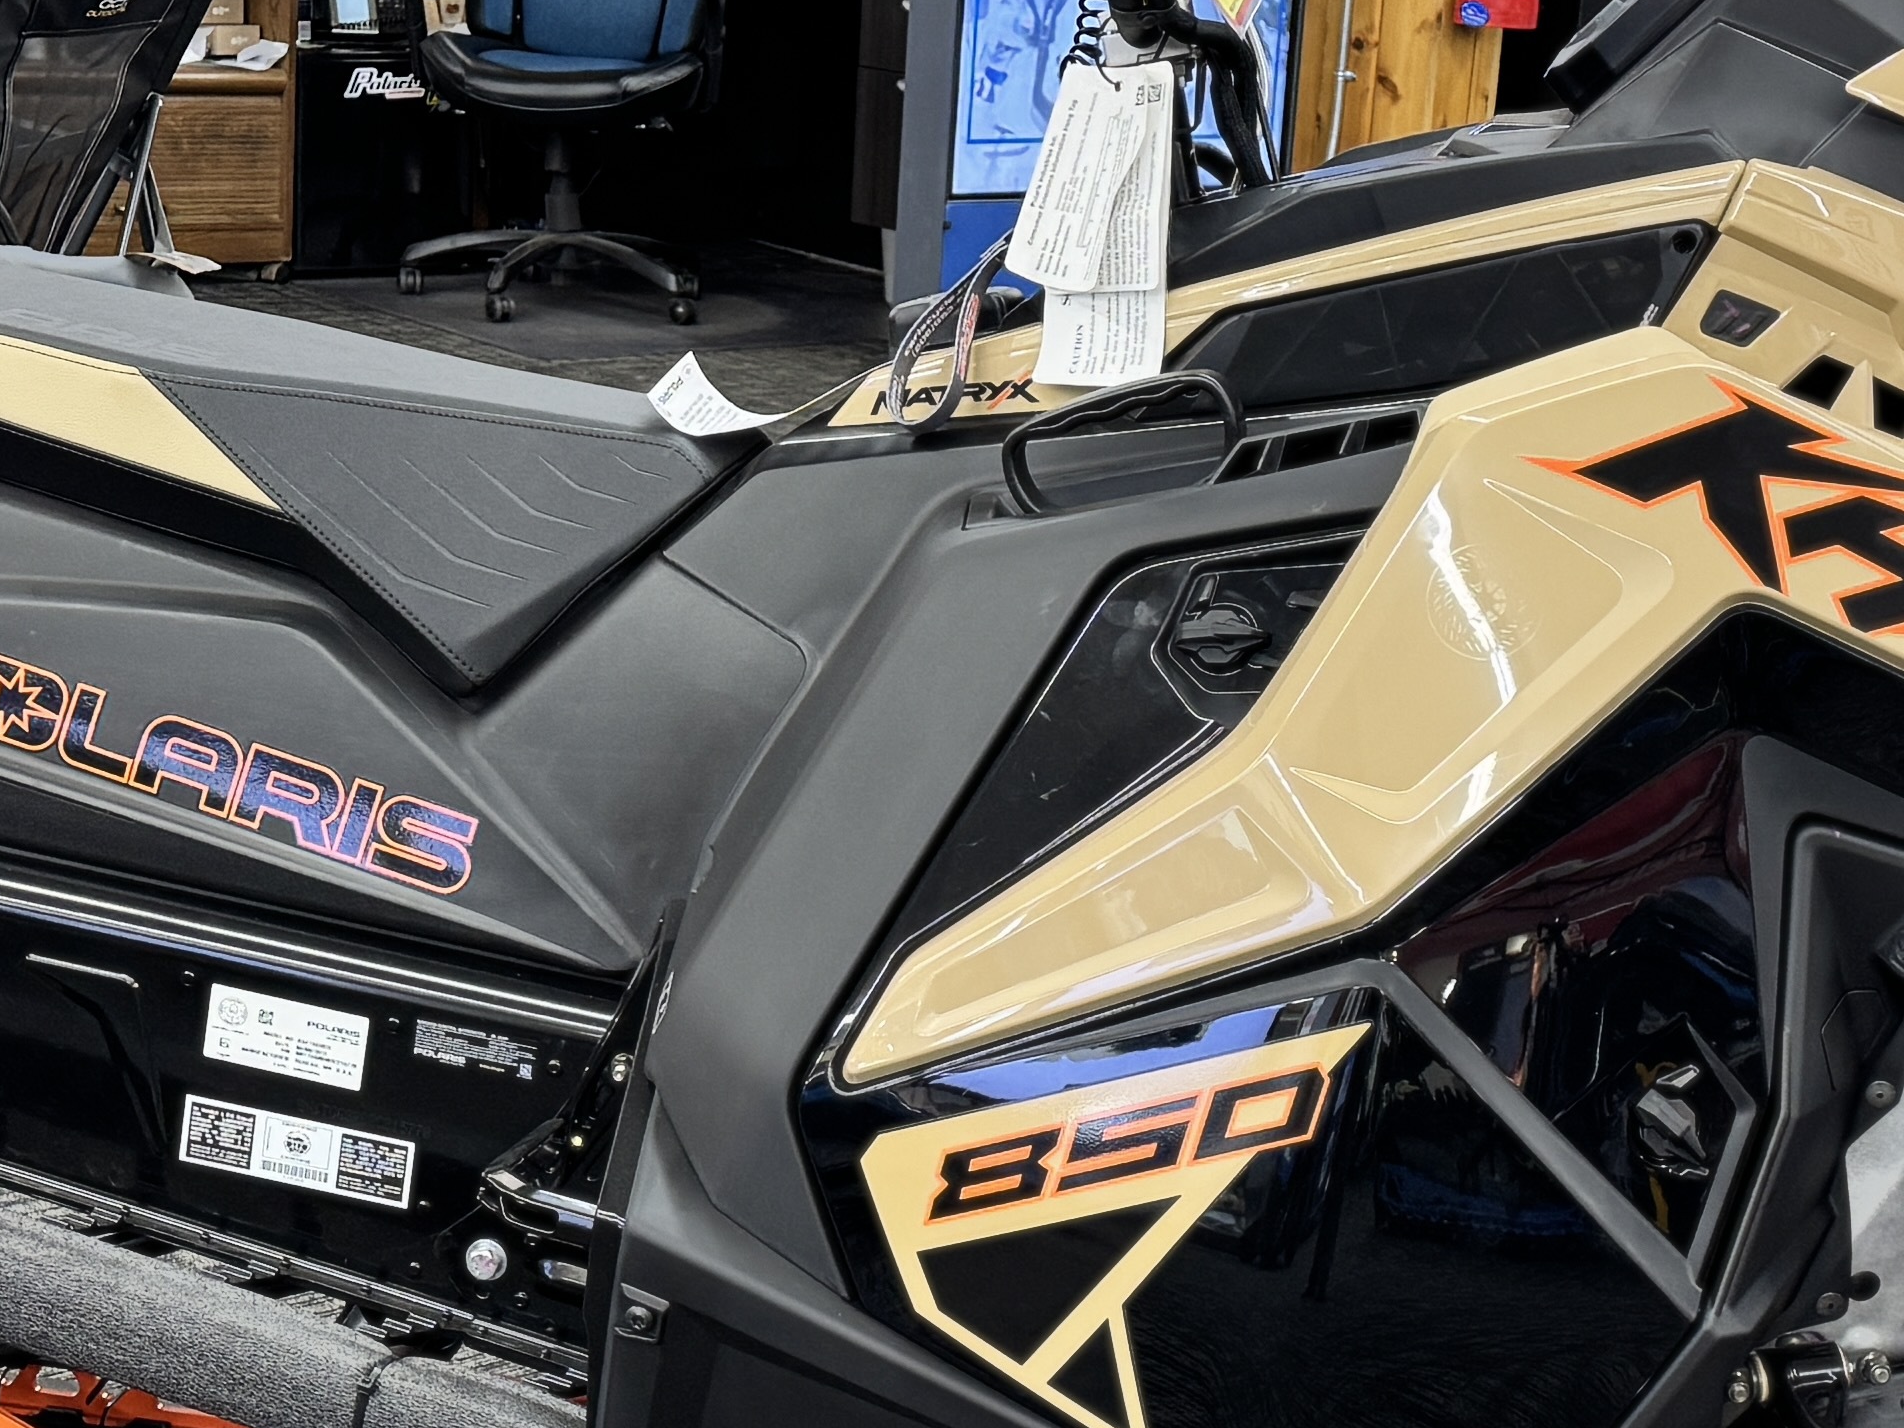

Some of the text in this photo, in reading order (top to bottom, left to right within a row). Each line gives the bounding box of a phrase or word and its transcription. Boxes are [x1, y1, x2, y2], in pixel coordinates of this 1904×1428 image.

[1066, 323, 1085, 376] CAUTION
[413, 1046, 467, 1065] POLARIS
[924, 1063, 1335, 1226] 850
